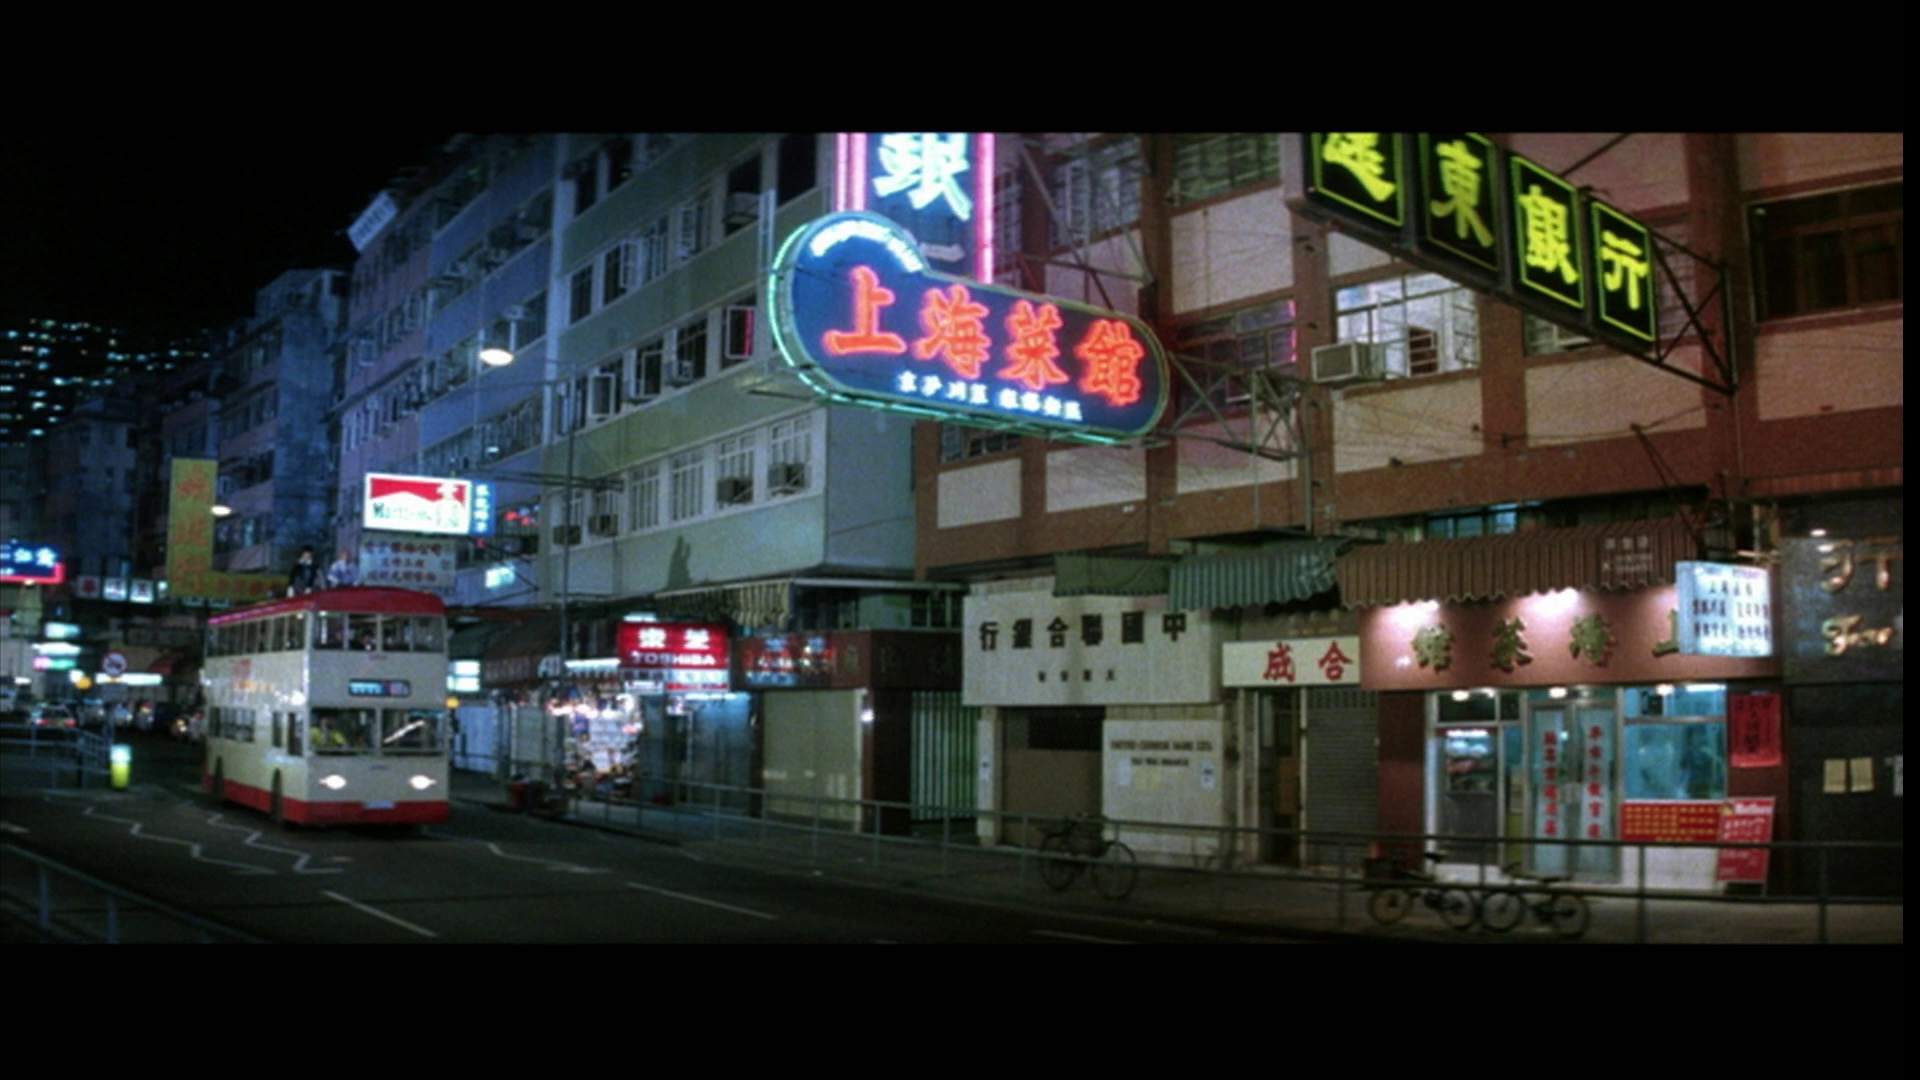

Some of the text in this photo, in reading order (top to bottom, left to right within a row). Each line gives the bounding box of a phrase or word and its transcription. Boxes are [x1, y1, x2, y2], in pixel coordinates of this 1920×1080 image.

[822, 266, 1146, 407] 上海菜館
[630, 651, 716, 665] TOSHIBA
